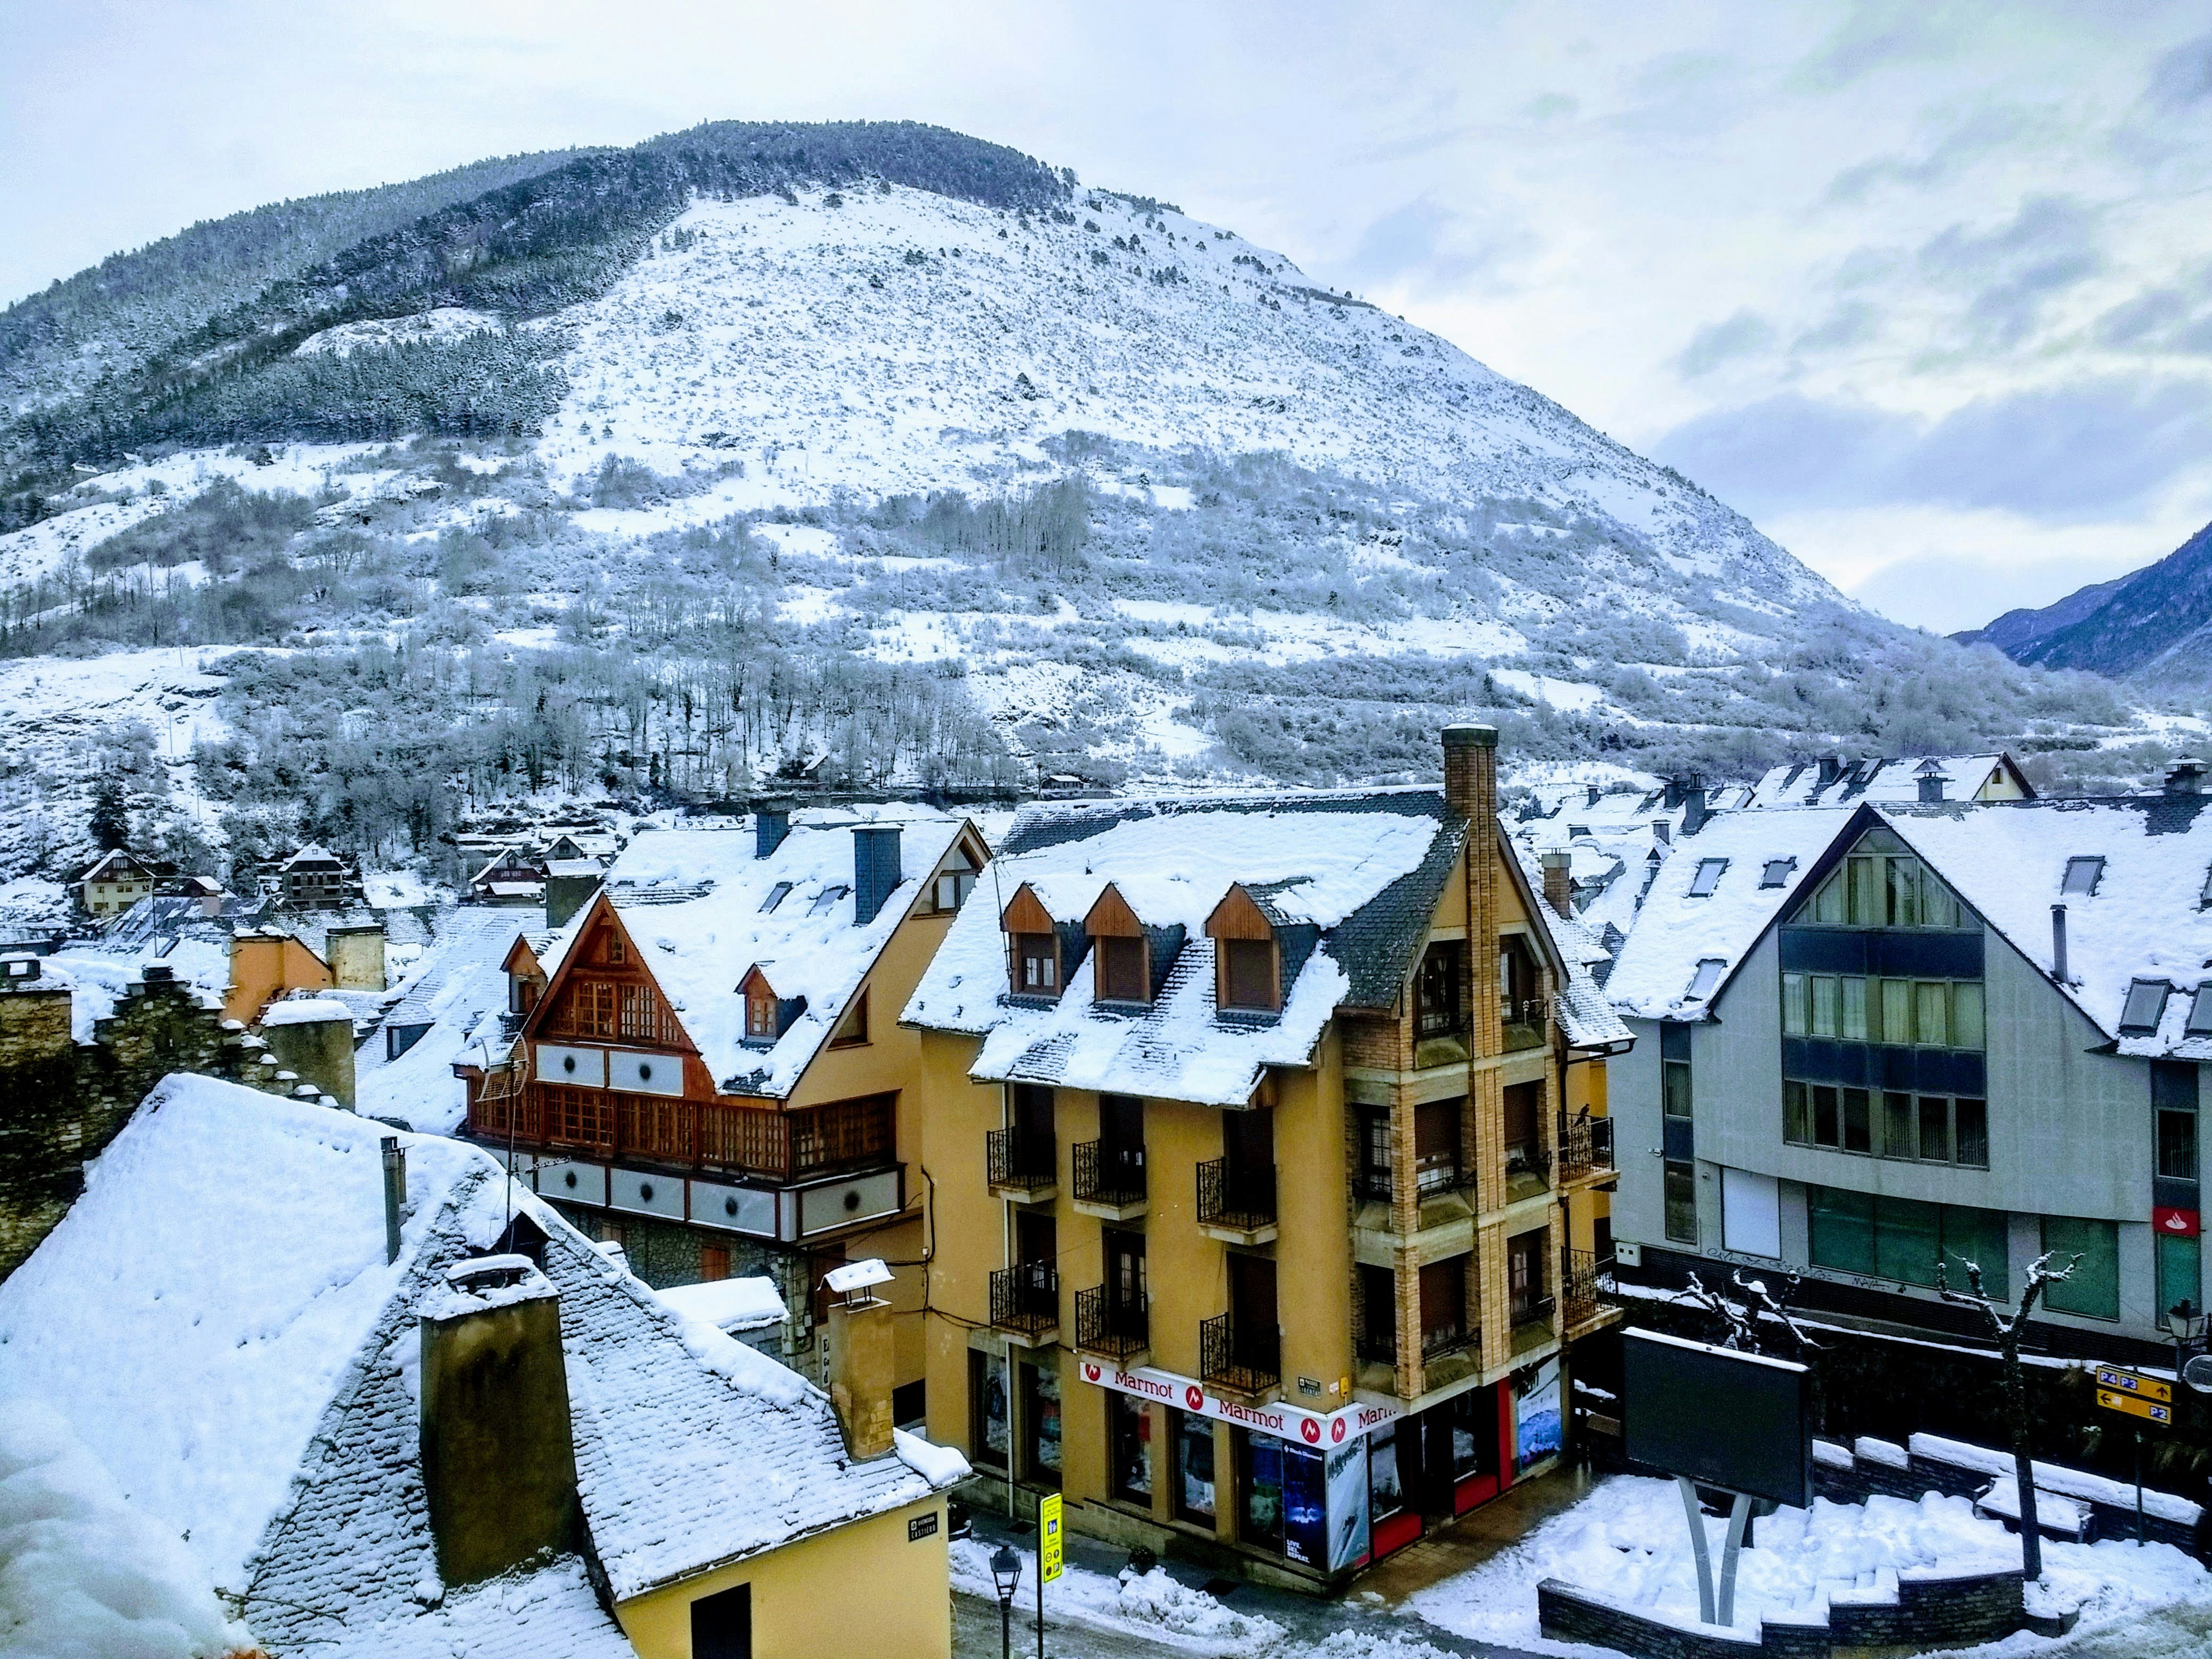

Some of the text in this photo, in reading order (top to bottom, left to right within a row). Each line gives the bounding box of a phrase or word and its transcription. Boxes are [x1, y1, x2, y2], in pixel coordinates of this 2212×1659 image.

[2100, 1371, 2138, 1389] P4 P3
[1115, 1371, 1172, 1399] Marmot
[1219, 1400, 1284, 1431] Marmot
[2150, 1407, 2167, 1419] P2
